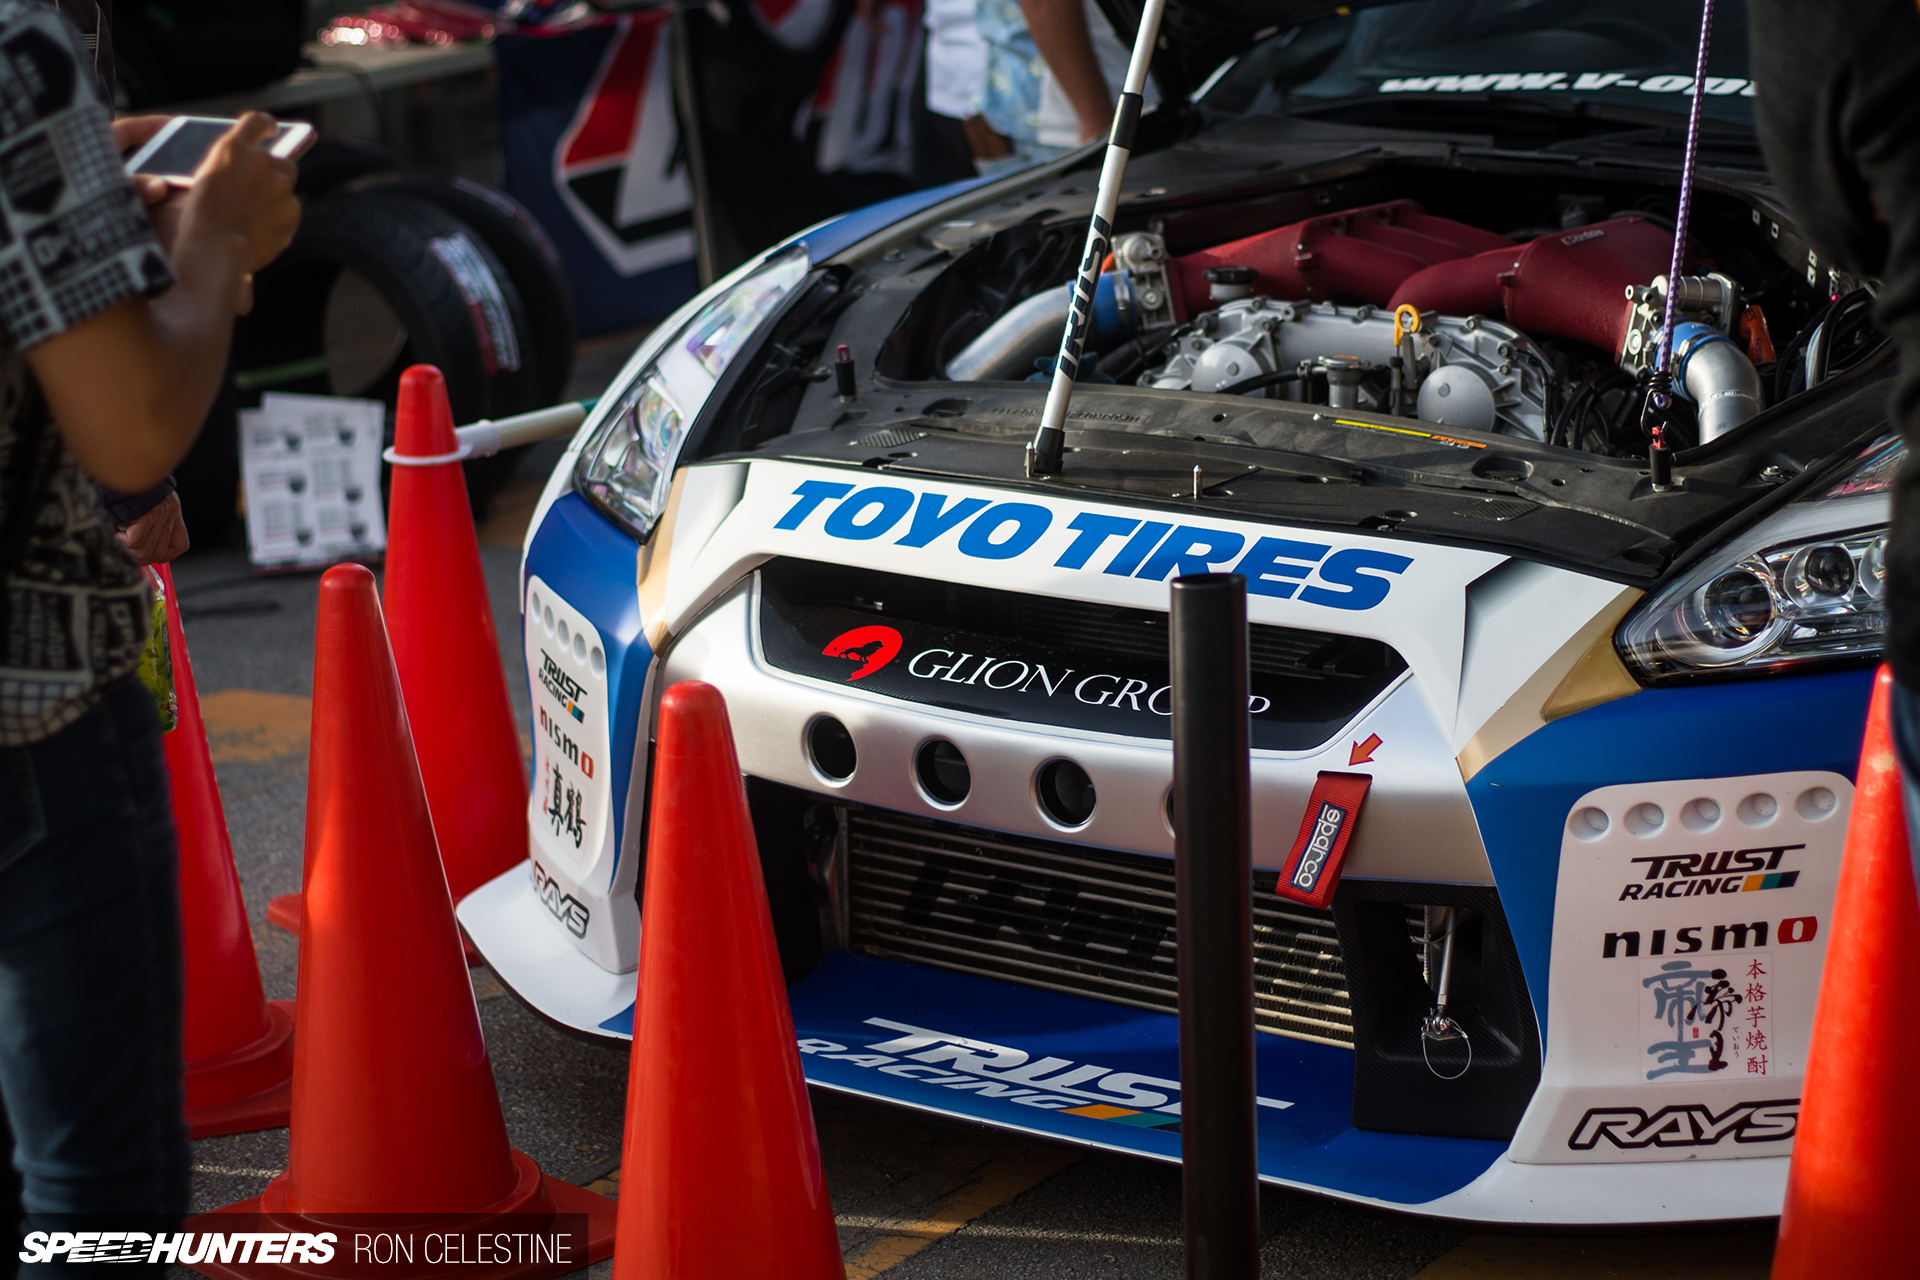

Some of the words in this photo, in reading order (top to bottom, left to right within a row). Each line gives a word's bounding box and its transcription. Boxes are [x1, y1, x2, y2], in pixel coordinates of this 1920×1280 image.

[772, 479, 1054, 560] TOYO
[1053, 512, 1415, 611] TIRES
[538, 667, 569, 708] RACING
[540, 647, 588, 703] TRUST
[908, 648, 1075, 697] GLION
[1073, 674, 1271, 716] GROP
[540, 703, 594, 780] nismo
[1293, 804, 1341, 888] sparco
[1630, 844, 1806, 880] TRUST
[534, 859, 590, 940] RAYS
[1618, 875, 1744, 901] RACING
[1602, 915, 1818, 959] nismo
[1745, 958, 1769, 1076] 本格芋焼酎
[797, 1038, 1092, 1109] RACING
[1568, 1098, 1801, 1150] RAYS
